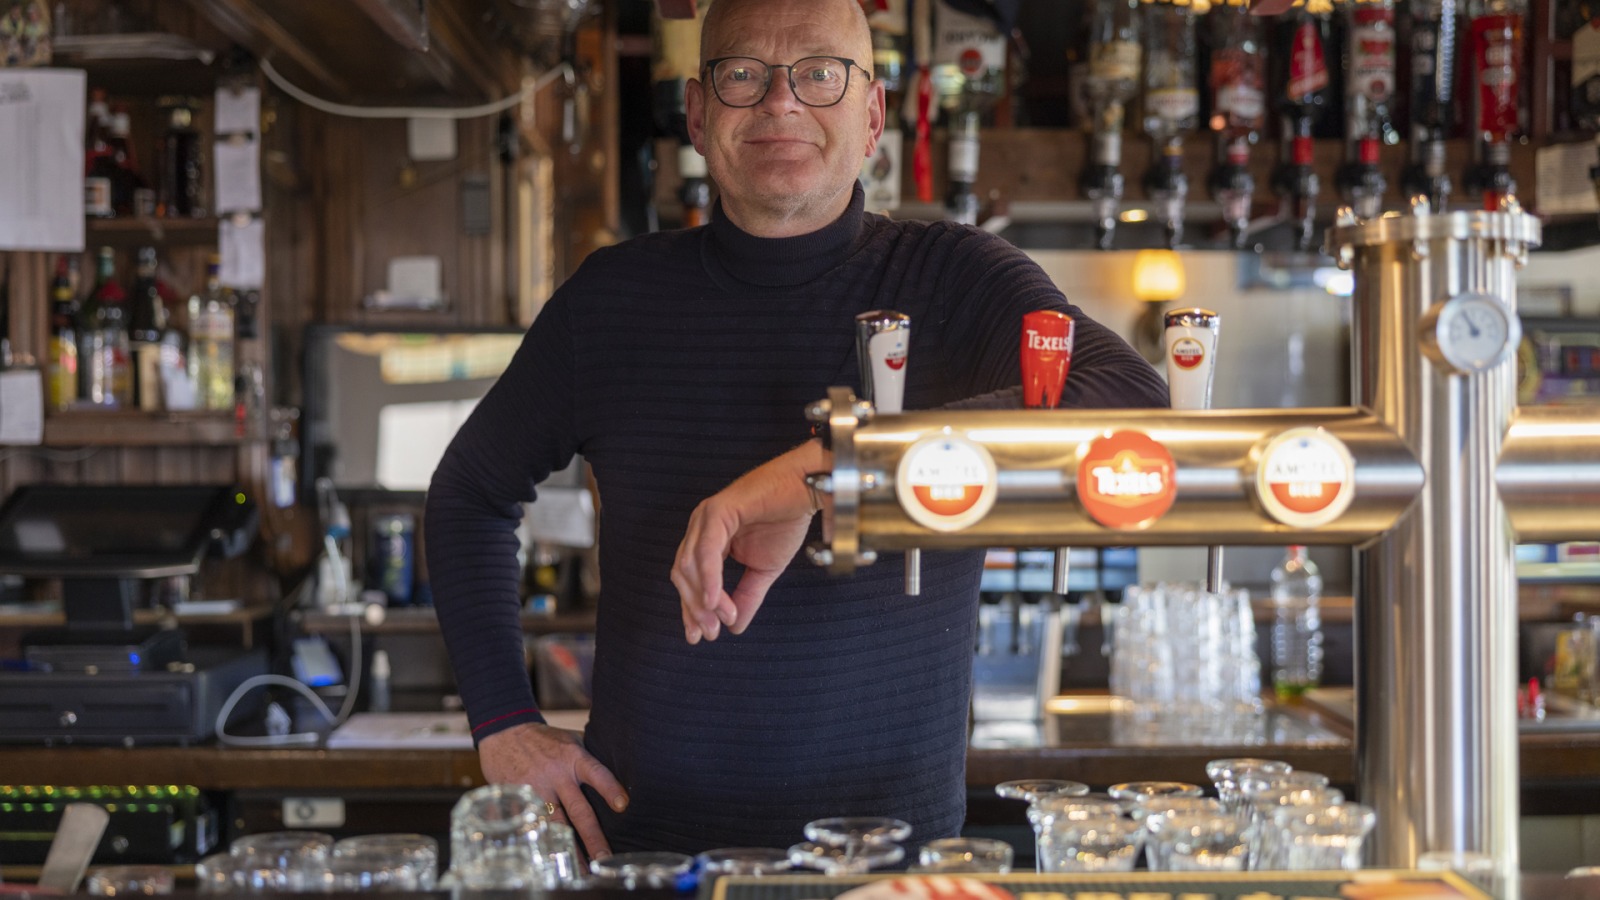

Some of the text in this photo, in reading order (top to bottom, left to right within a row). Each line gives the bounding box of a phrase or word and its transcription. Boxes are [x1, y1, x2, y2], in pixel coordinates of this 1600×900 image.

[1026, 329, 1071, 351] TEXELS
[917, 464, 978, 478] AMTEL
[1092, 466, 1163, 495] TEXELS
